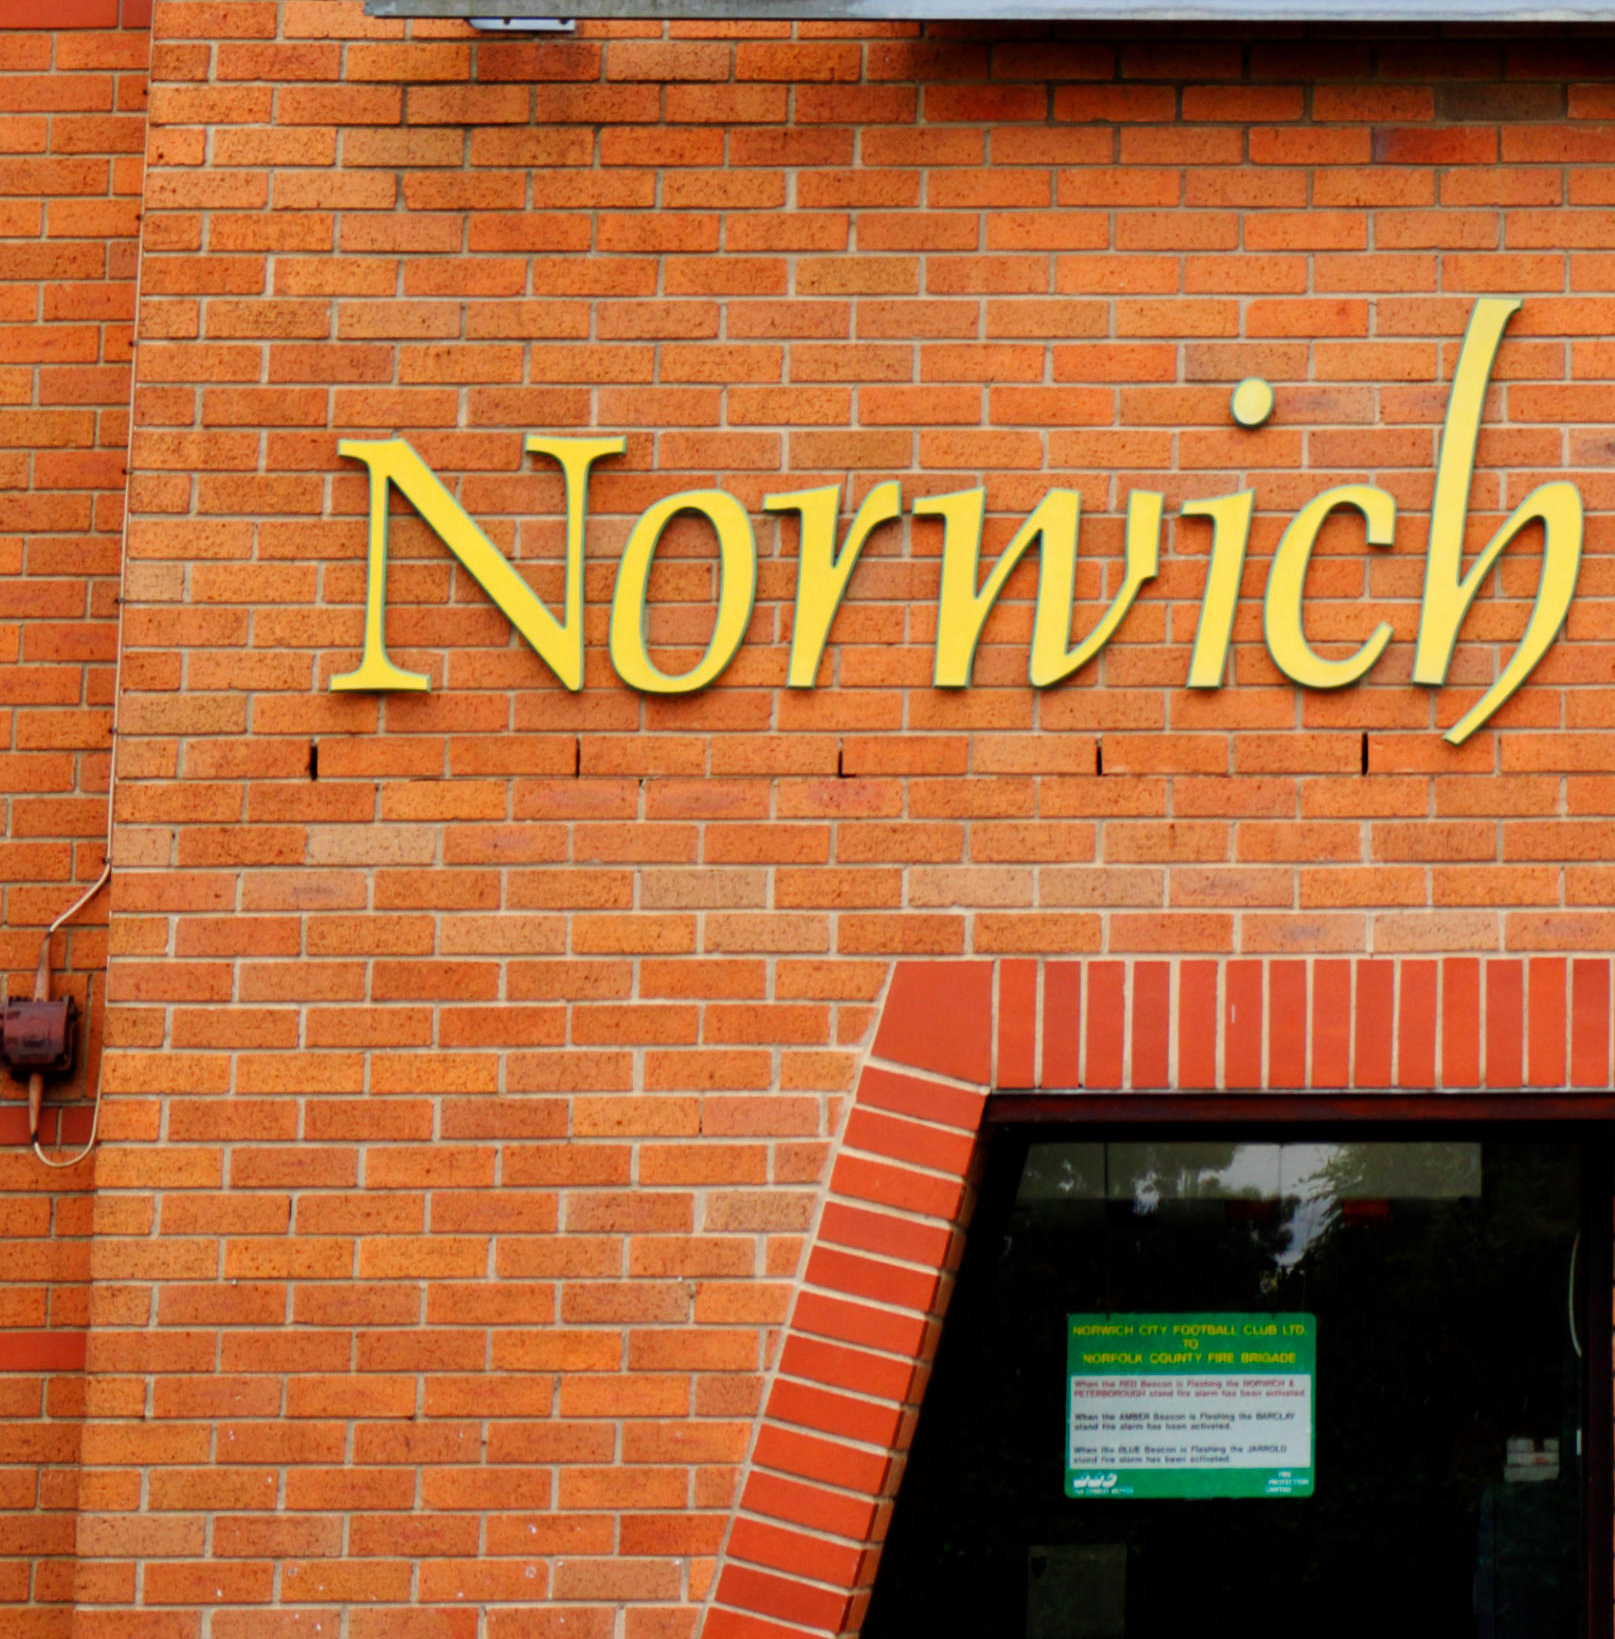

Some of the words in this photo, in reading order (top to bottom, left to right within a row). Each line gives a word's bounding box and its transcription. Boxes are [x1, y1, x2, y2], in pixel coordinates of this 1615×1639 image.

[329, 297, 1584, 747] Norwich
[1072, 1324, 1134, 1336] NORWICH
[1138, 1324, 1167, 1336] CITY
[1172, 1324, 1236, 1336] FOOTBALL
[1243, 1324, 1278, 1336] CLUB
[1182, 1338, 1200, 1350] TO
[1082, 1352, 1143, 1364] NORFOLK
[1149, 1352, 1202, 1364] COUNTY
[1208, 1352, 1235, 1364] FIRE
[1241, 1352, 1297, 1364] BRIGADE
[1102, 1379, 1115, 1388] the
[1119, 1379, 1137, 1388] RED
[1226, 1379, 1239, 1388] the
[1102, 1412, 1115, 1421] the
[1119, 1412, 1150, 1421] AMBER
[1239, 1412, 1252, 1421] the
